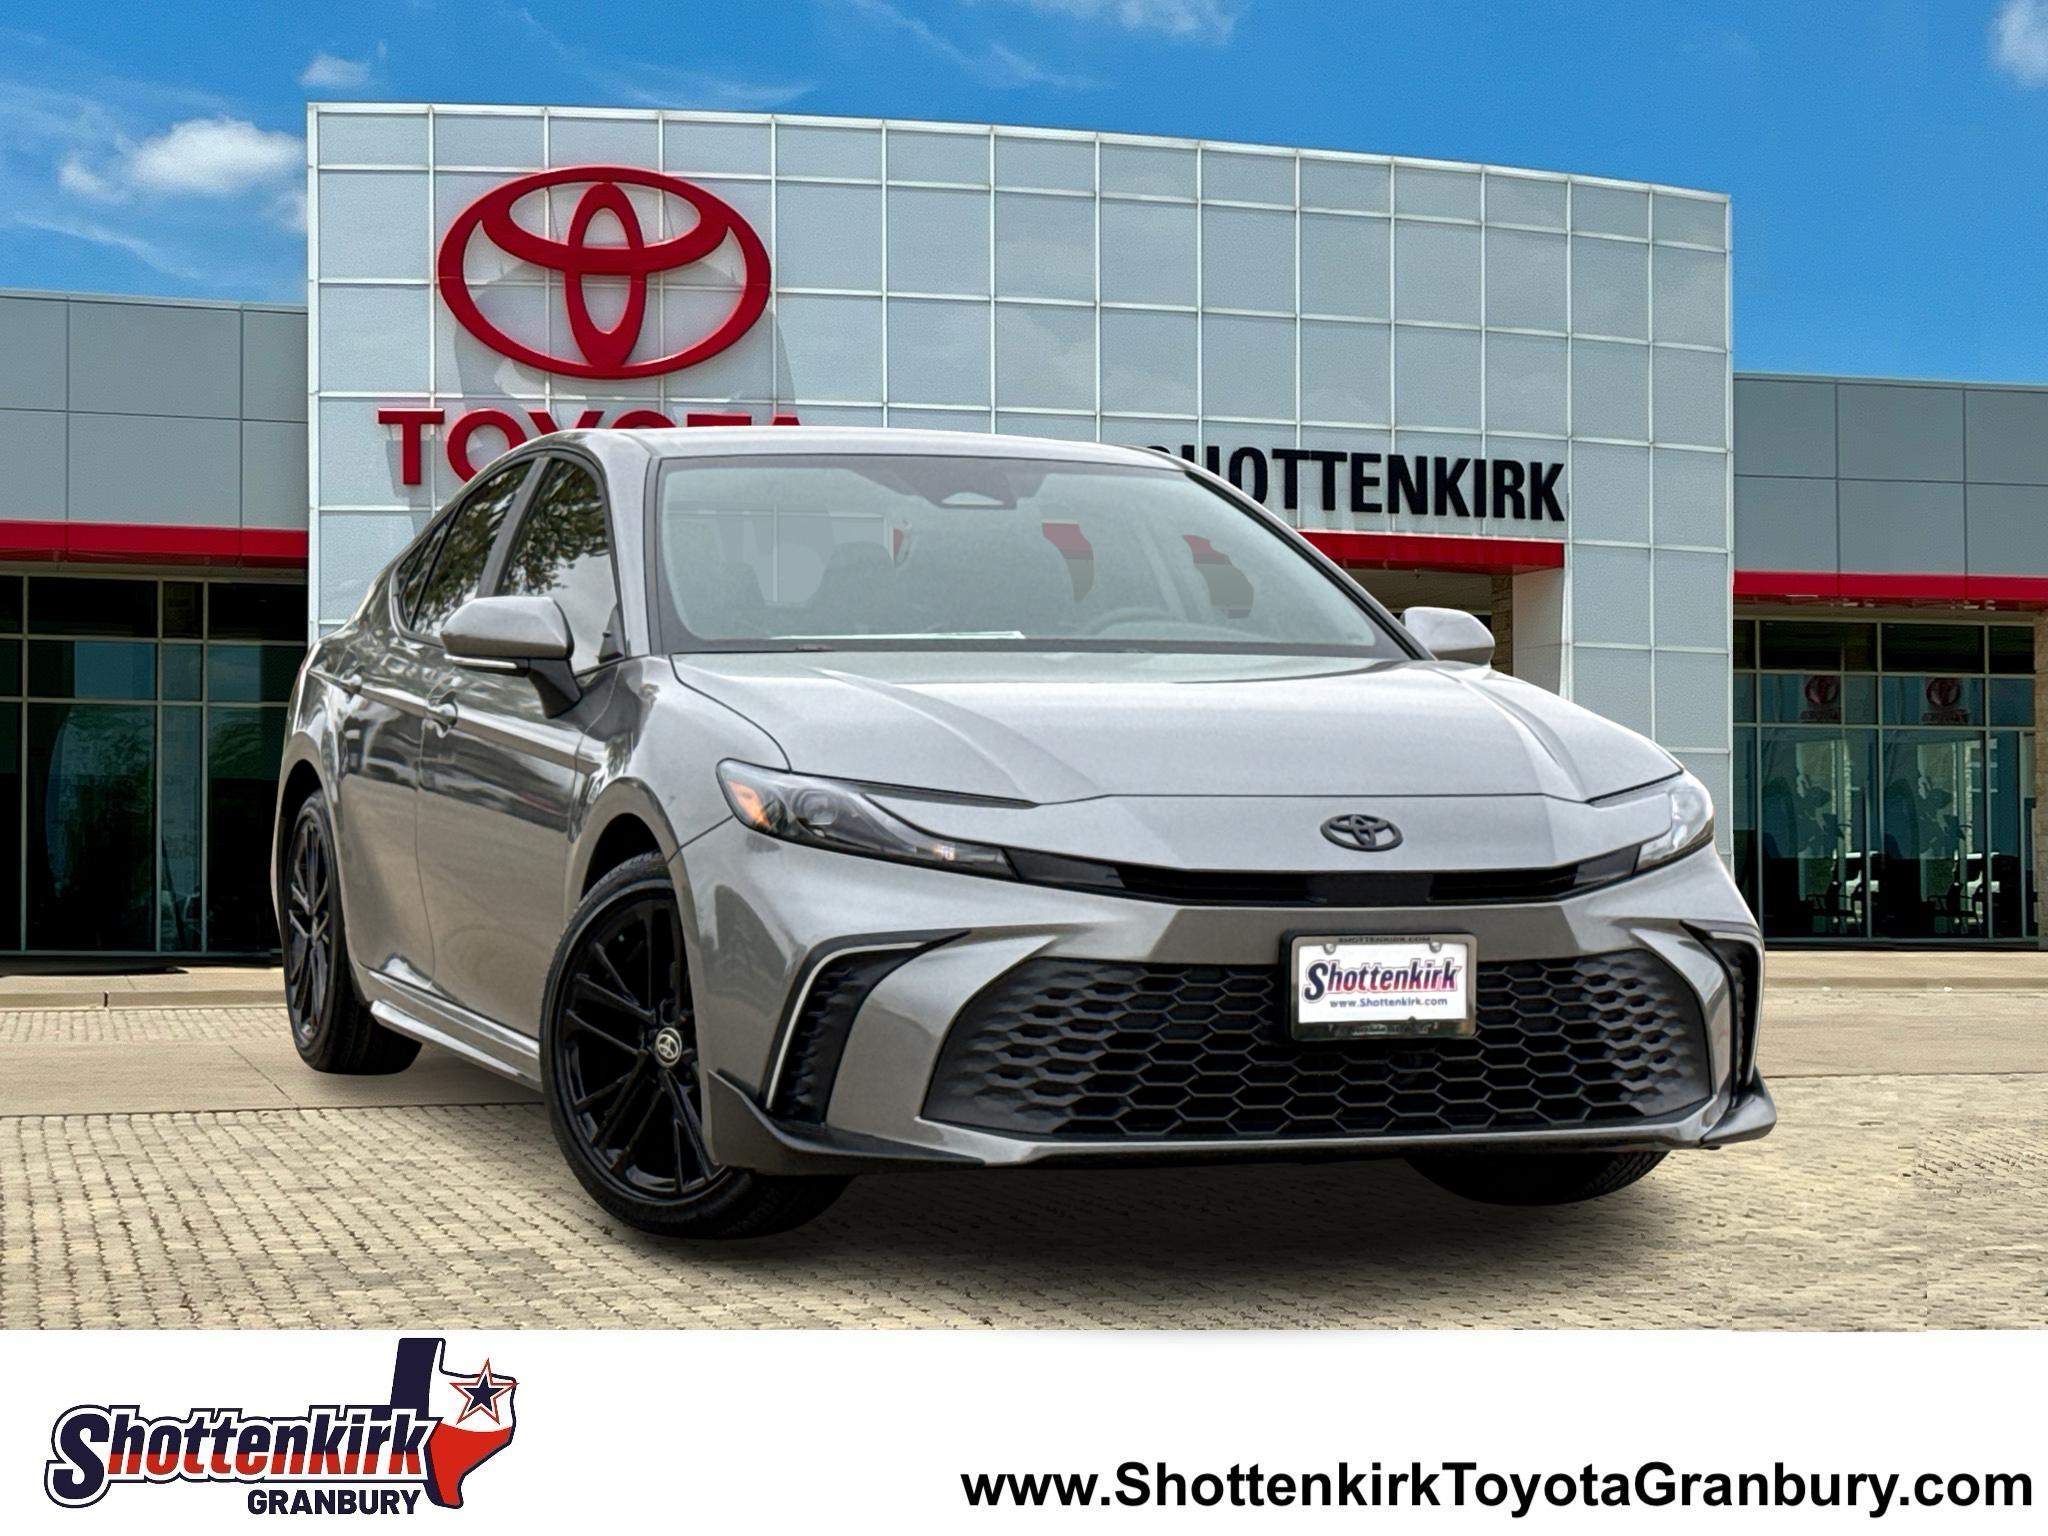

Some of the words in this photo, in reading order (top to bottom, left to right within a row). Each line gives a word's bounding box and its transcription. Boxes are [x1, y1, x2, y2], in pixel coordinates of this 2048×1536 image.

[1146, 445, 1566, 522] OTTENKIRK
[1304, 959, 1461, 1001] Shottenkirk
[1329, 997, 1448, 1008] www.Shottenkirk.com
